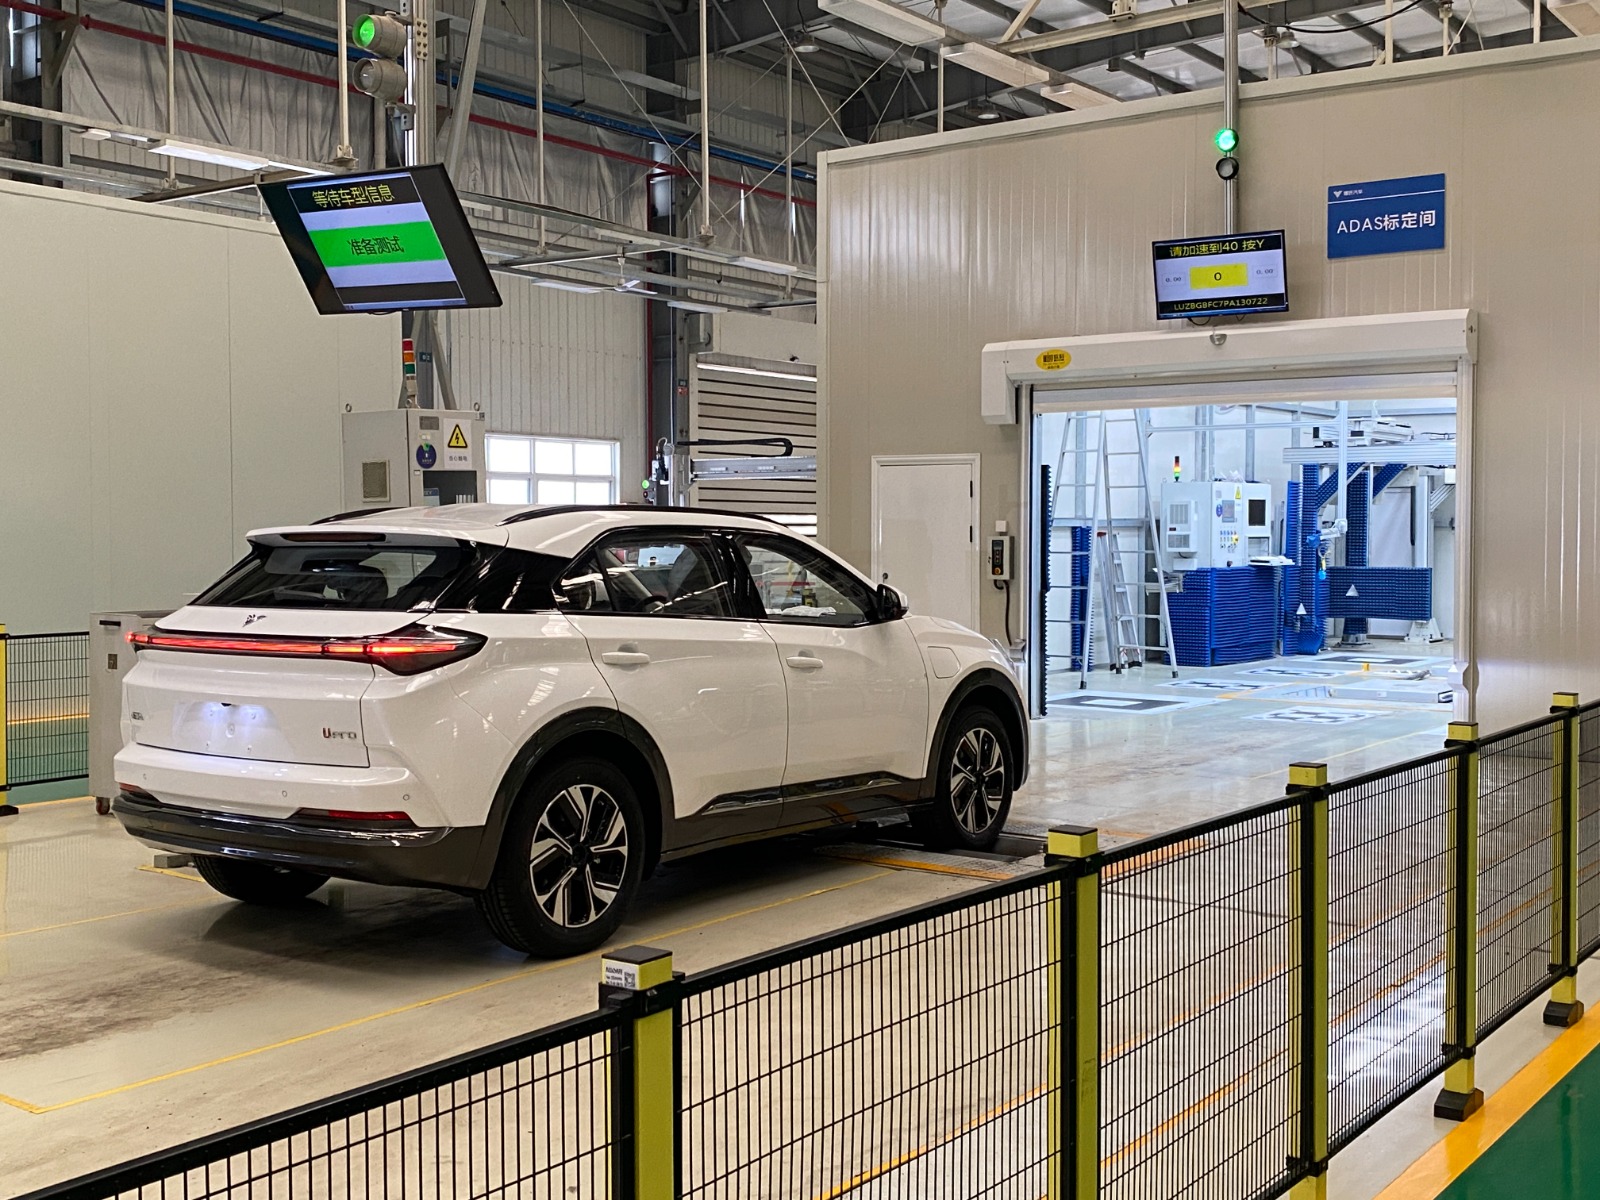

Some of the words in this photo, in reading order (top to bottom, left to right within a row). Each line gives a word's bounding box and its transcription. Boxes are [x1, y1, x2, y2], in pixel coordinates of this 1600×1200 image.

[312, 184, 395, 208] 等待车型信息
[1336, 210, 1436, 234] ADAS标定间
[347, 236, 404, 256] 准备测试
[1169, 242, 1239, 257] 请加速到40
[1242, 239, 1265, 251] 按Y
